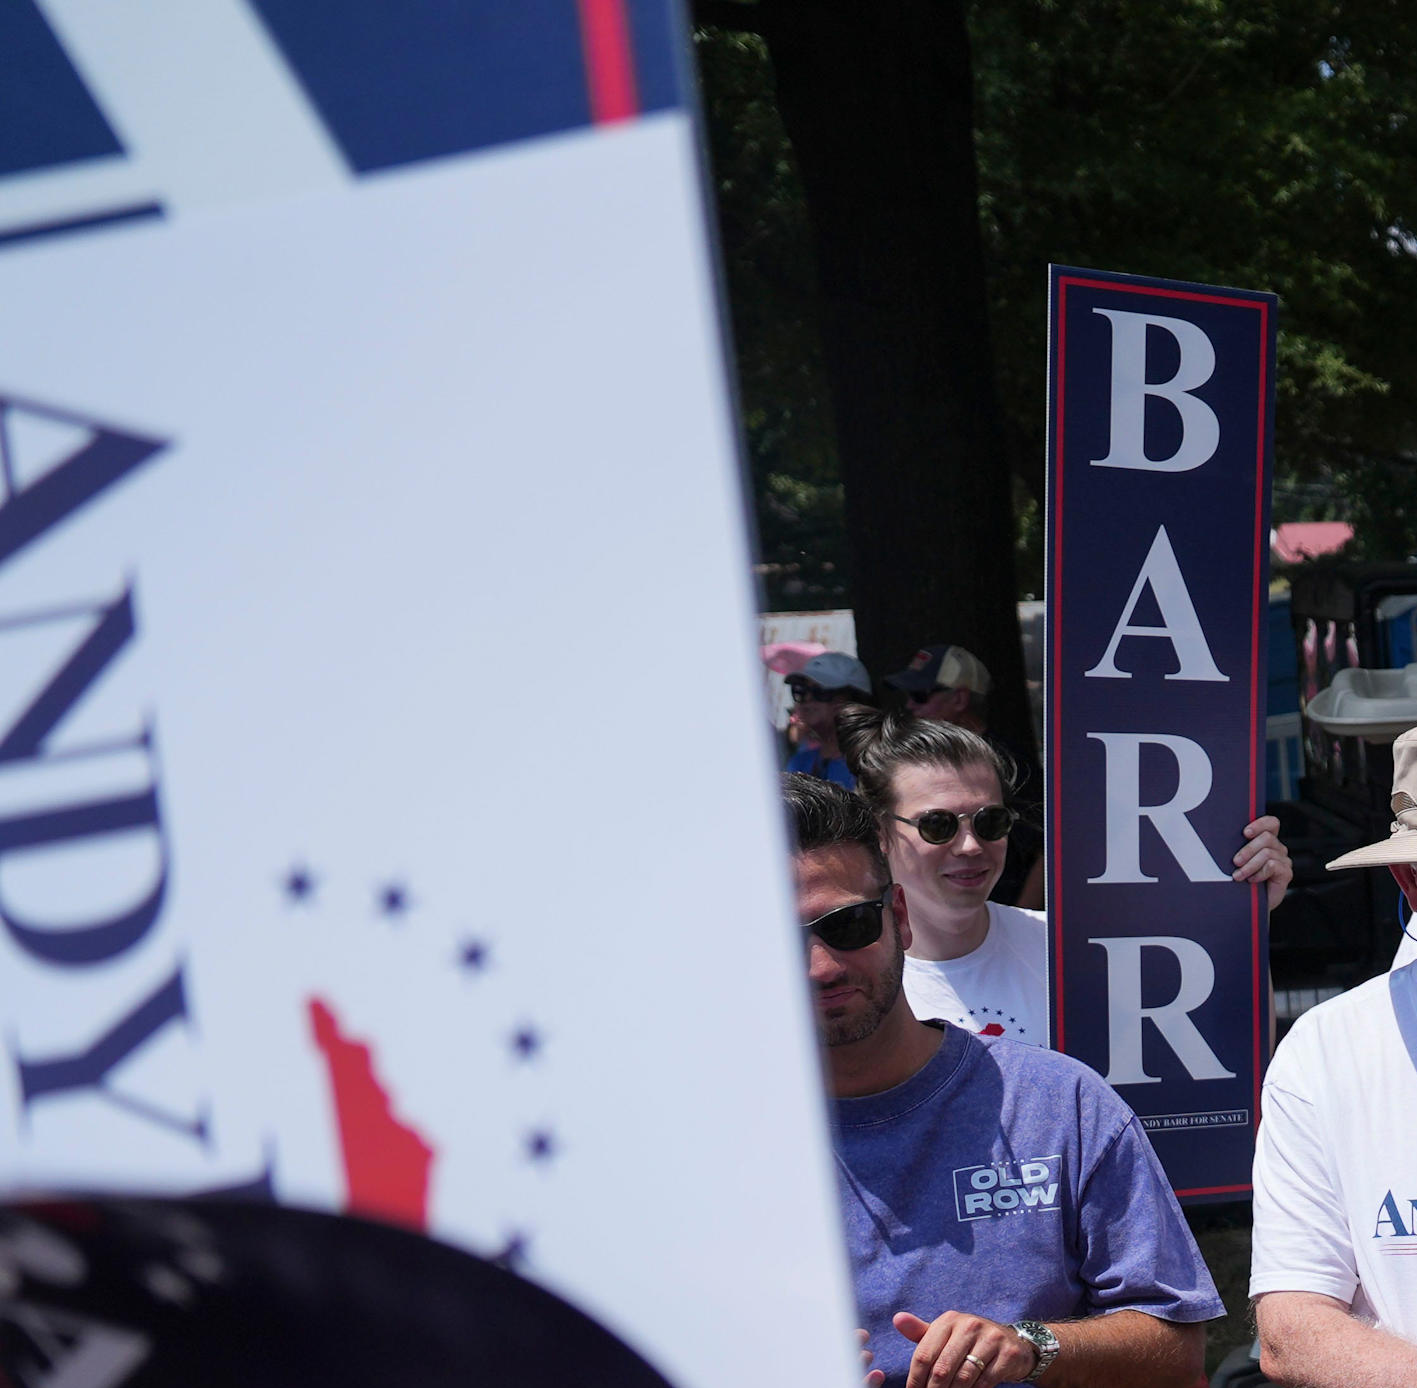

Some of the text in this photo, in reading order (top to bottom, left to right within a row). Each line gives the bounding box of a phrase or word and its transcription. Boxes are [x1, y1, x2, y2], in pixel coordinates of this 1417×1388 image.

[1084, 308, 1237, 1085] BARR
[1163, 1116, 1188, 1128] BARR
[1189, 1114, 1208, 1126] FOR
[1208, 1113, 1244, 1125] SENATE
[970, 1162, 1049, 1191] OLD
[964, 1183, 1059, 1216] ROW
